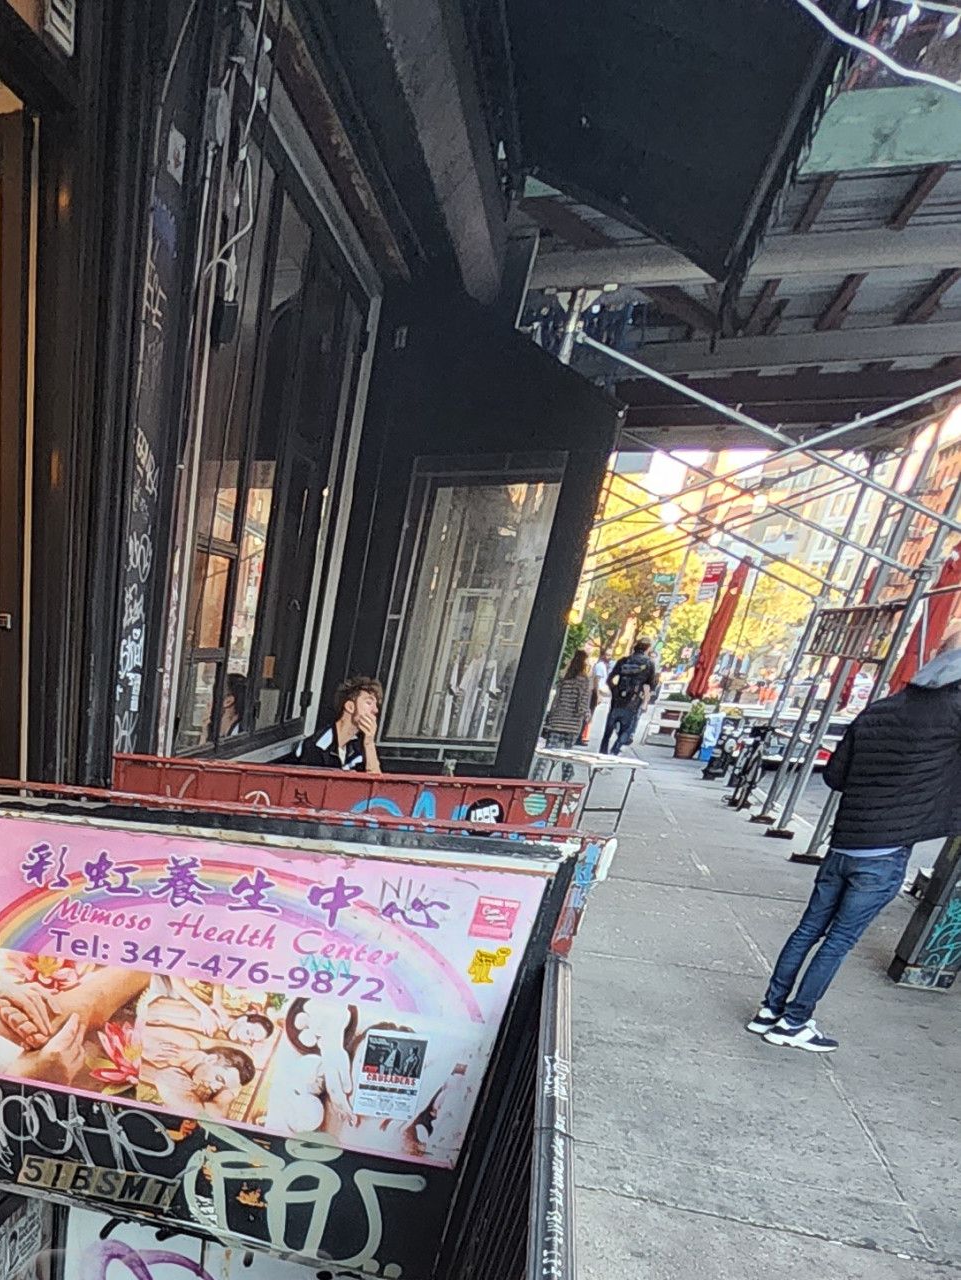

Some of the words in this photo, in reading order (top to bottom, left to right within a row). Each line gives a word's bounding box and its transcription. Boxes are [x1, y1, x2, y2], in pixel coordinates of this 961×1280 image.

[21, 842, 452, 931] 彩虹養生中心
[43, 897, 151, 932] Mimoso
[168, 920, 278, 953] Health
[293, 930, 401, 967] Center
[49, 930, 109, 961] Tel:
[121, 941, 386, 1003] 347-476-9872
